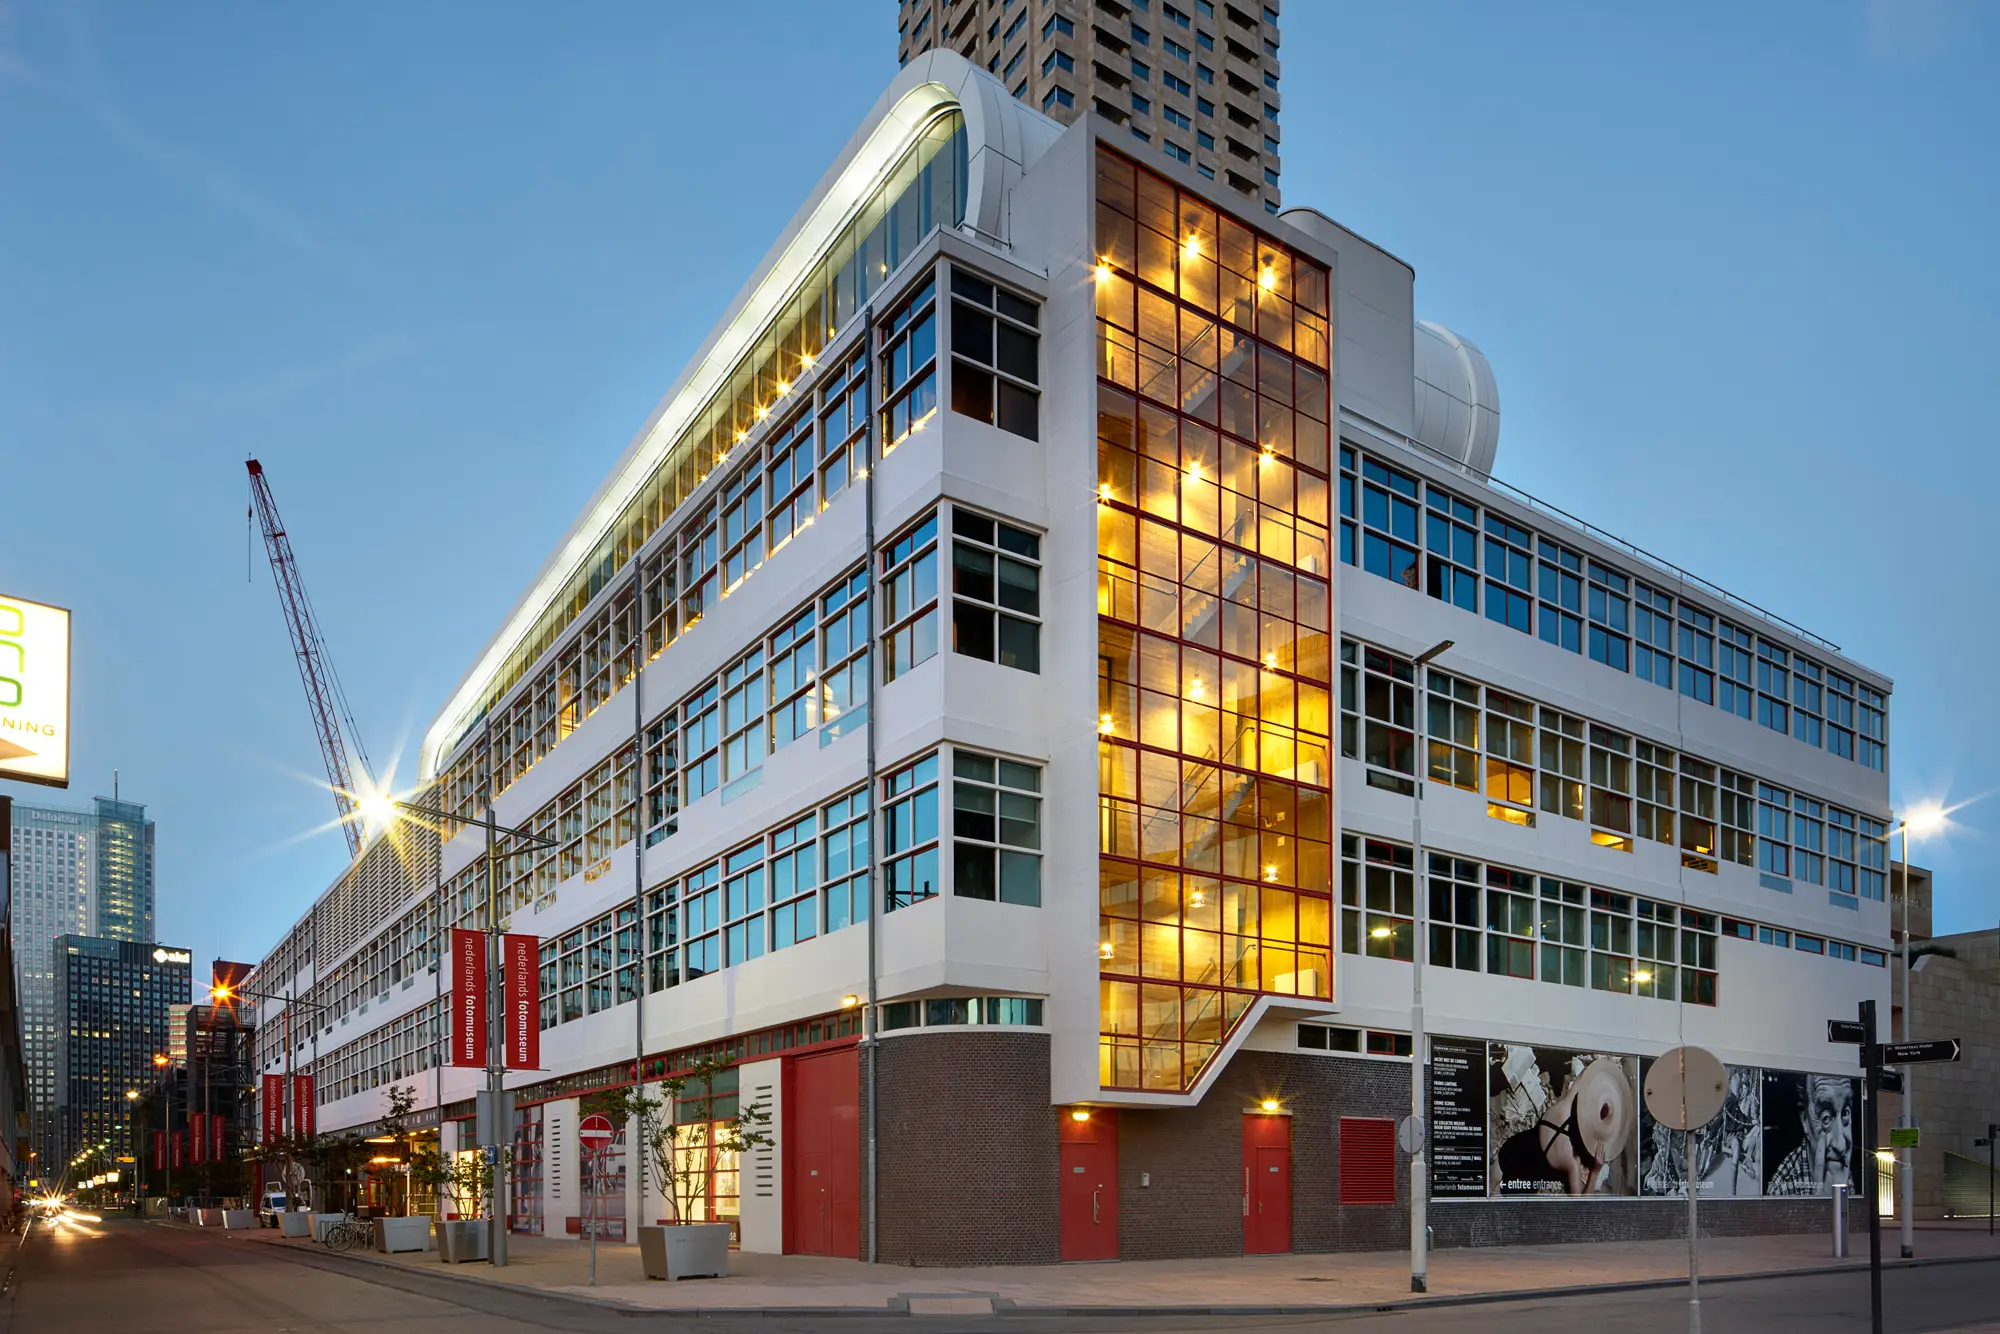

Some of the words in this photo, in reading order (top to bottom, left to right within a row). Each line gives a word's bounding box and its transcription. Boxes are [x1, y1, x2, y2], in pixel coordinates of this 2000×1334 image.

[465, 938, 476, 992] nederlands
[517, 942, 529, 997] nederlands
[465, 995, 477, 1060] fotomuseum
[518, 1000, 530, 1062] fotomuseum
[1508, 1178, 1531, 1189] entree
[1532, 1179, 1562, 1189] entrance
